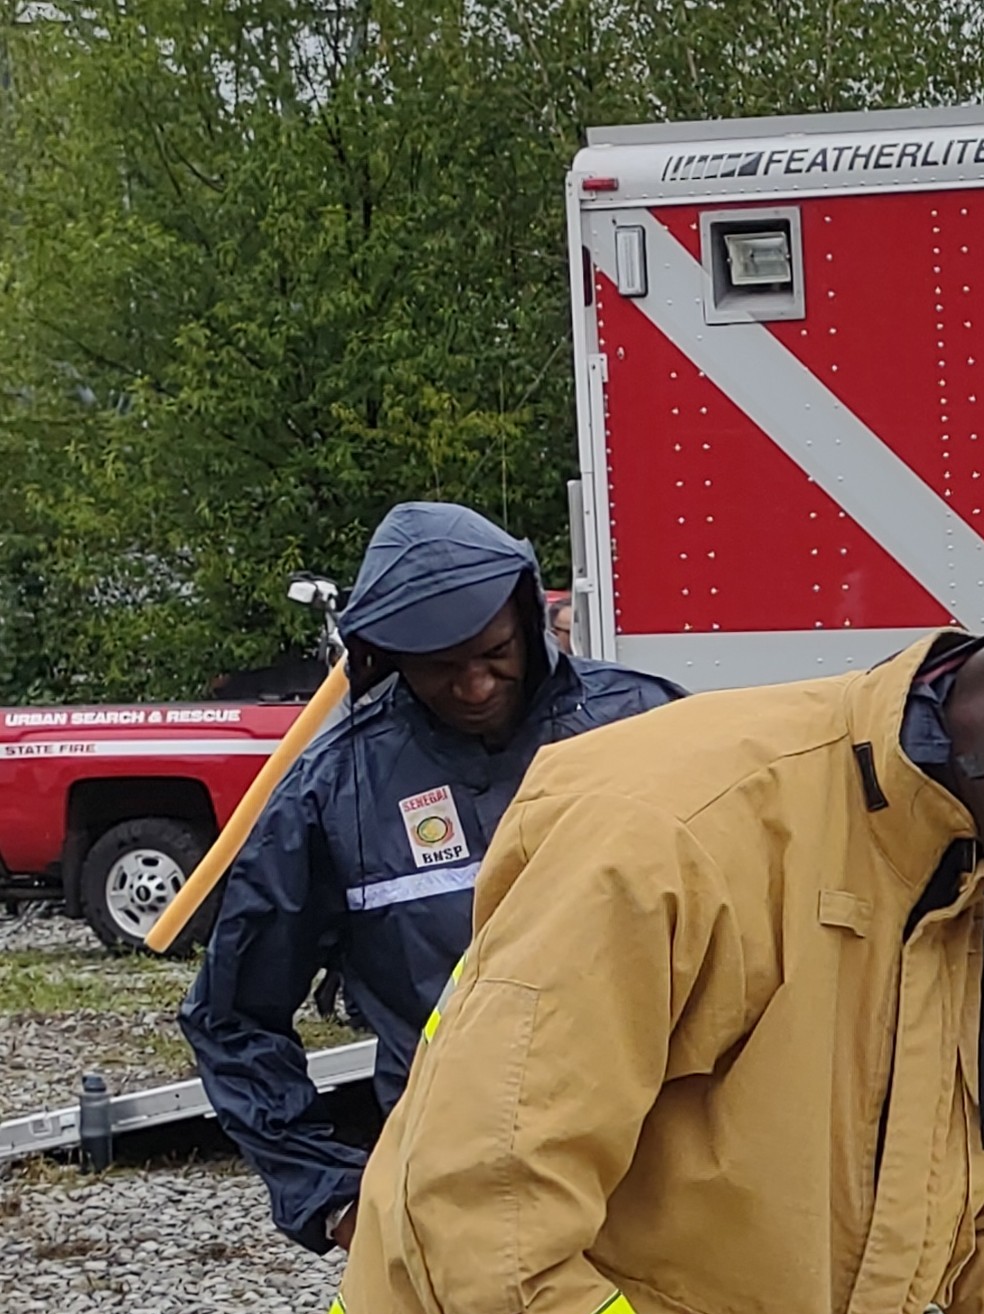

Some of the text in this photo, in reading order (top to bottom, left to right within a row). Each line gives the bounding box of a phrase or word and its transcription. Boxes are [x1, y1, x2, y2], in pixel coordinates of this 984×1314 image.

[5, 709, 242, 727] URBAN SEARCH & RESCUE
[5, 743, 97, 756] STATE FIRE
[422, 845, 463, 864] BNSP
